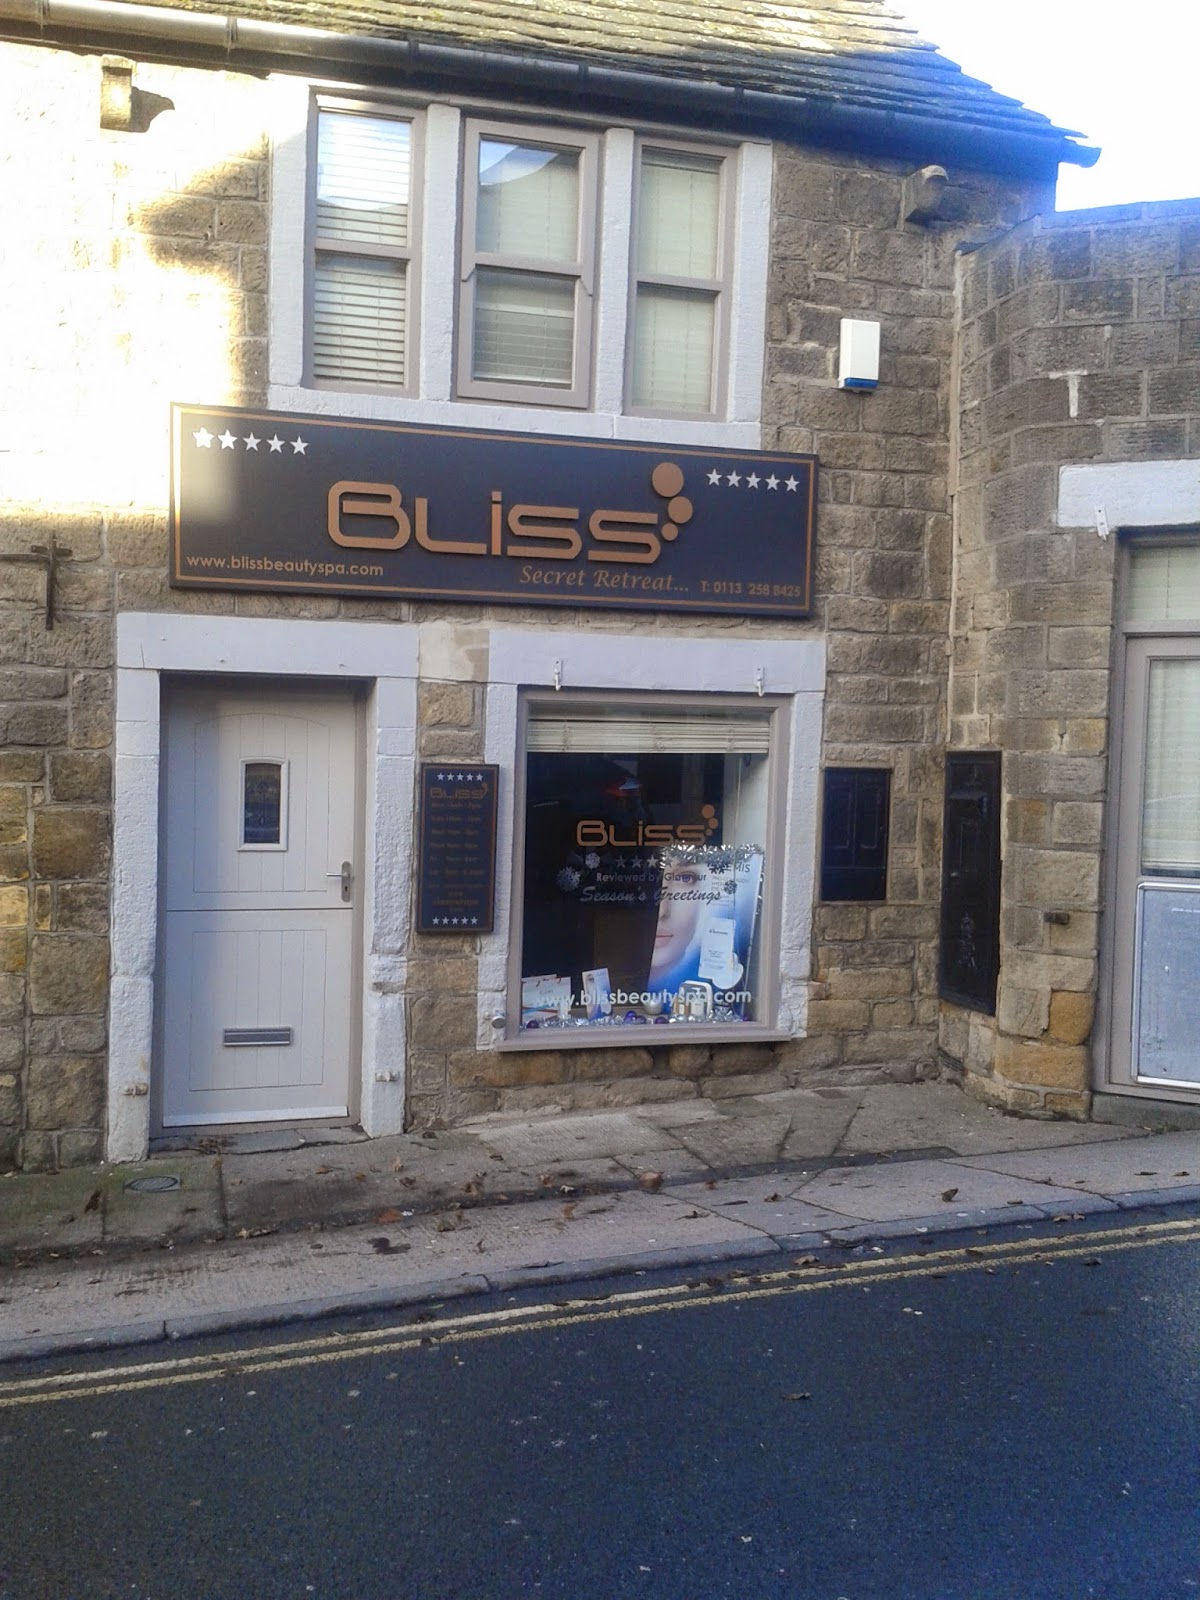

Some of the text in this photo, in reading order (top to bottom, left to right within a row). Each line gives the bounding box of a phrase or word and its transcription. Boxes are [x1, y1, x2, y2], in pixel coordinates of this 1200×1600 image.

[187, 555, 383, 577] www.blissbeautyspa.com
[520, 565, 689, 593] Secret Retreat...
[713, 581, 742, 594] 0113
[749, 583, 770, 596] 258
[596, 872, 646, 882] Reviewed
[664, 872, 707, 882] Glaur
[580, 886, 722, 906] Season's Greetings
